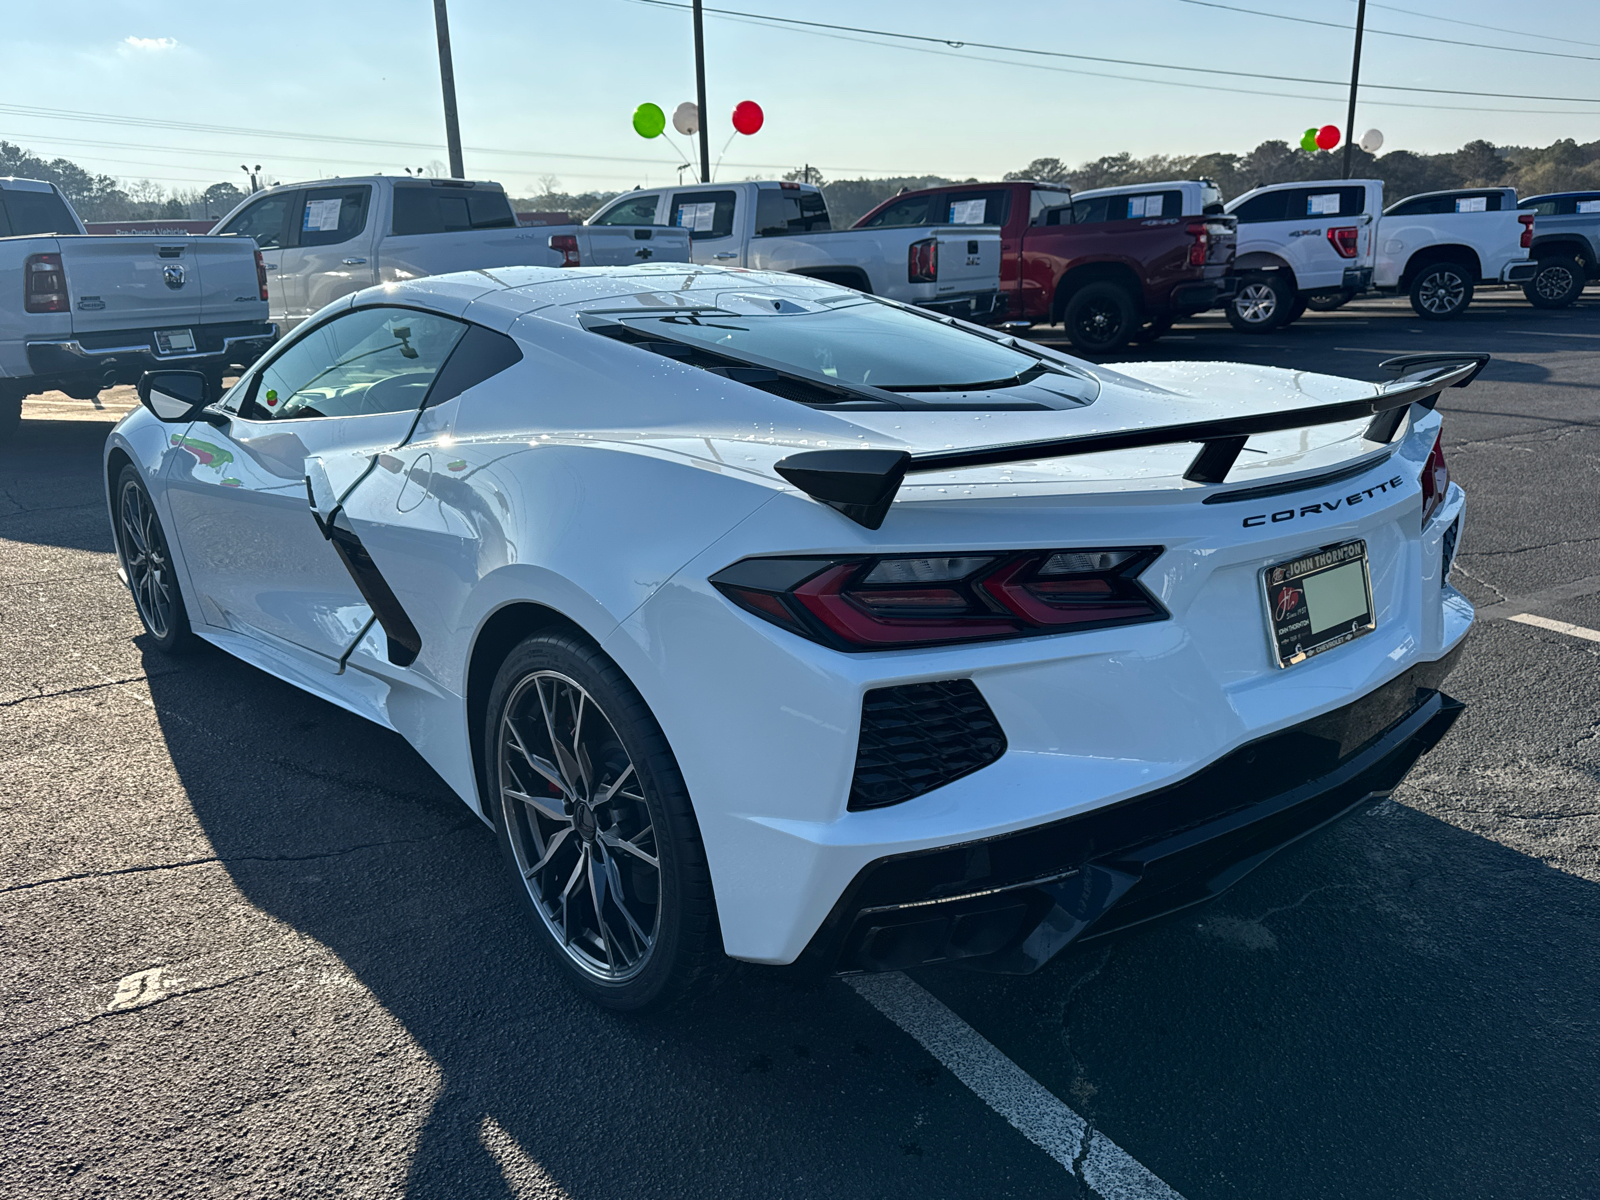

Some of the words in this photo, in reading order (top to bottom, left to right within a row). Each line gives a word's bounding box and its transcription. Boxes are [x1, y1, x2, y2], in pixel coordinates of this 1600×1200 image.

[1242, 475, 1403, 528] CORVETTE
[1289, 558, 1314, 576] JOHN
[1314, 543, 1361, 568] THORNTON
[1316, 637, 1344, 653] CHEVROLET
